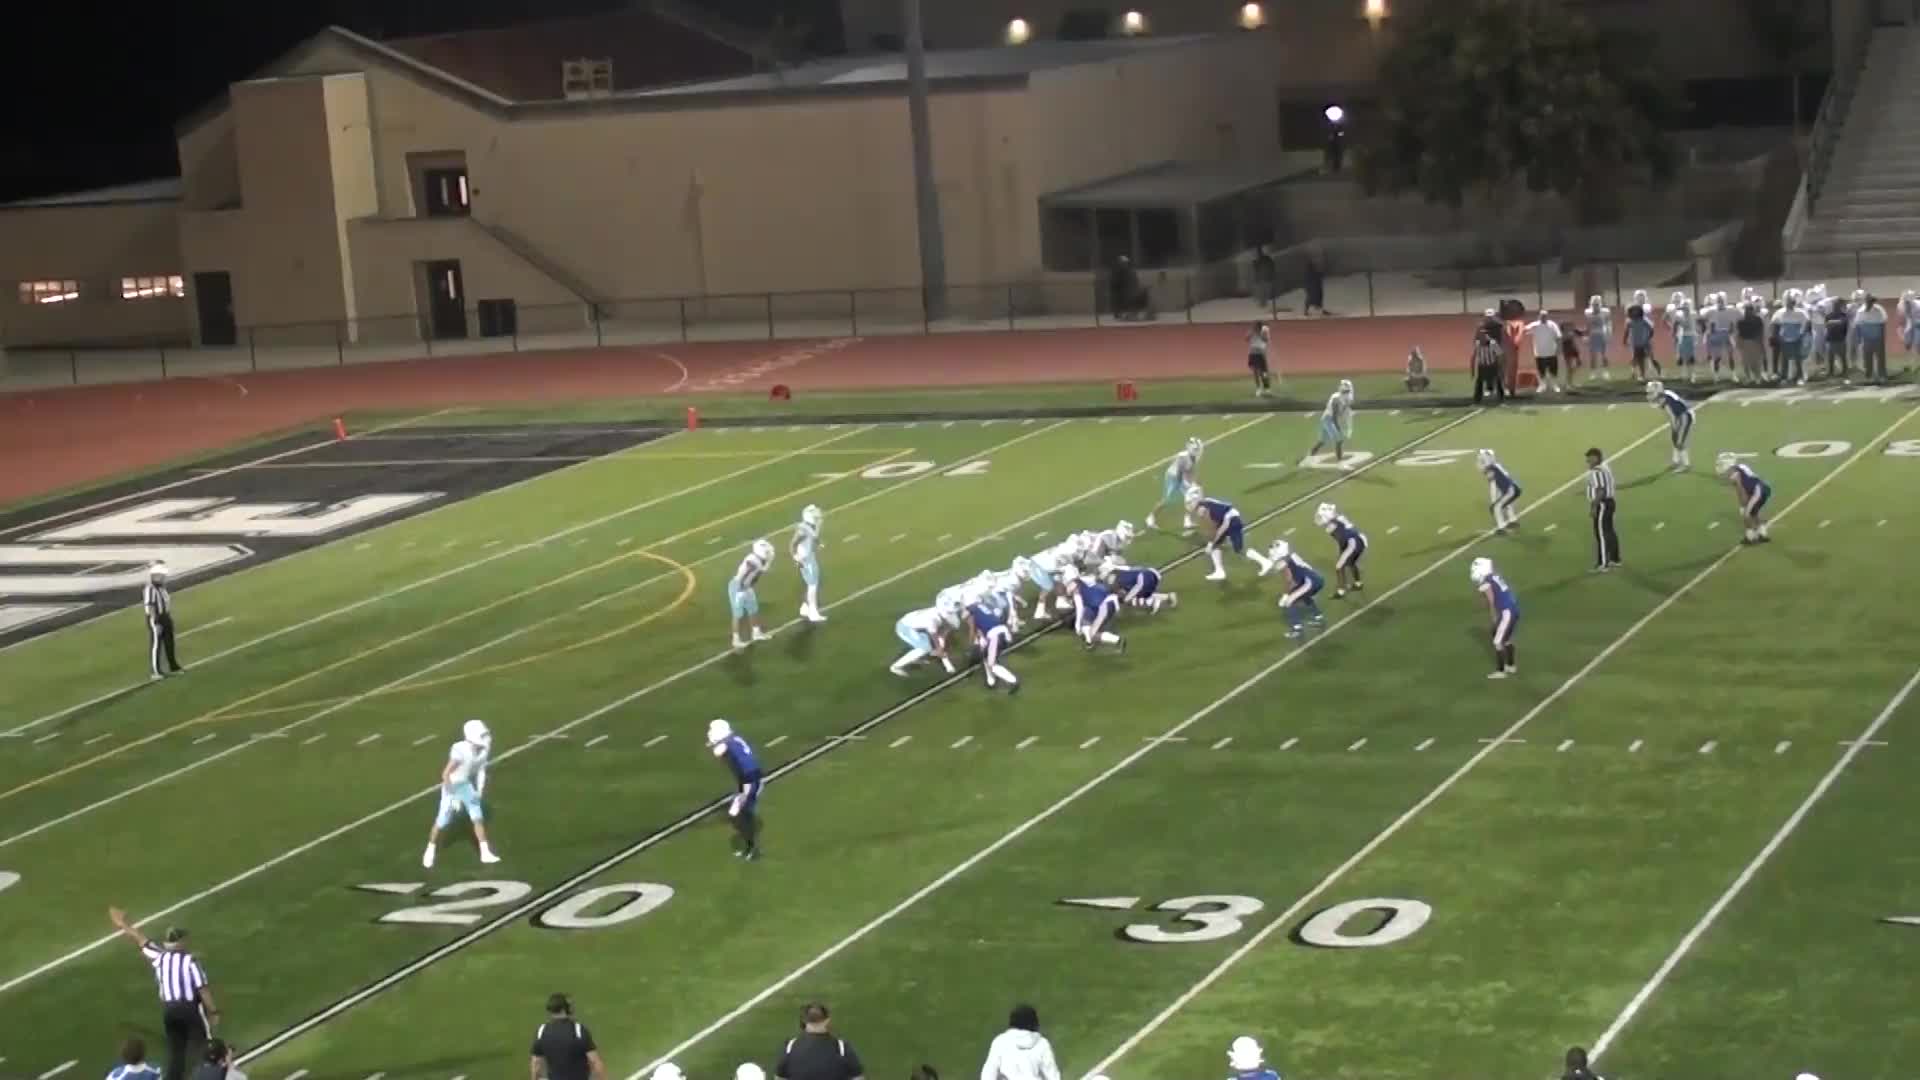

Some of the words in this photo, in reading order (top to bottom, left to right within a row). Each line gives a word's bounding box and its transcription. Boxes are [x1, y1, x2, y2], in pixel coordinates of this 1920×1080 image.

[859, 460, 991, 479] 10
[378, 879, 675, 928] 20
[1124, 894, 1433, 947] 30
